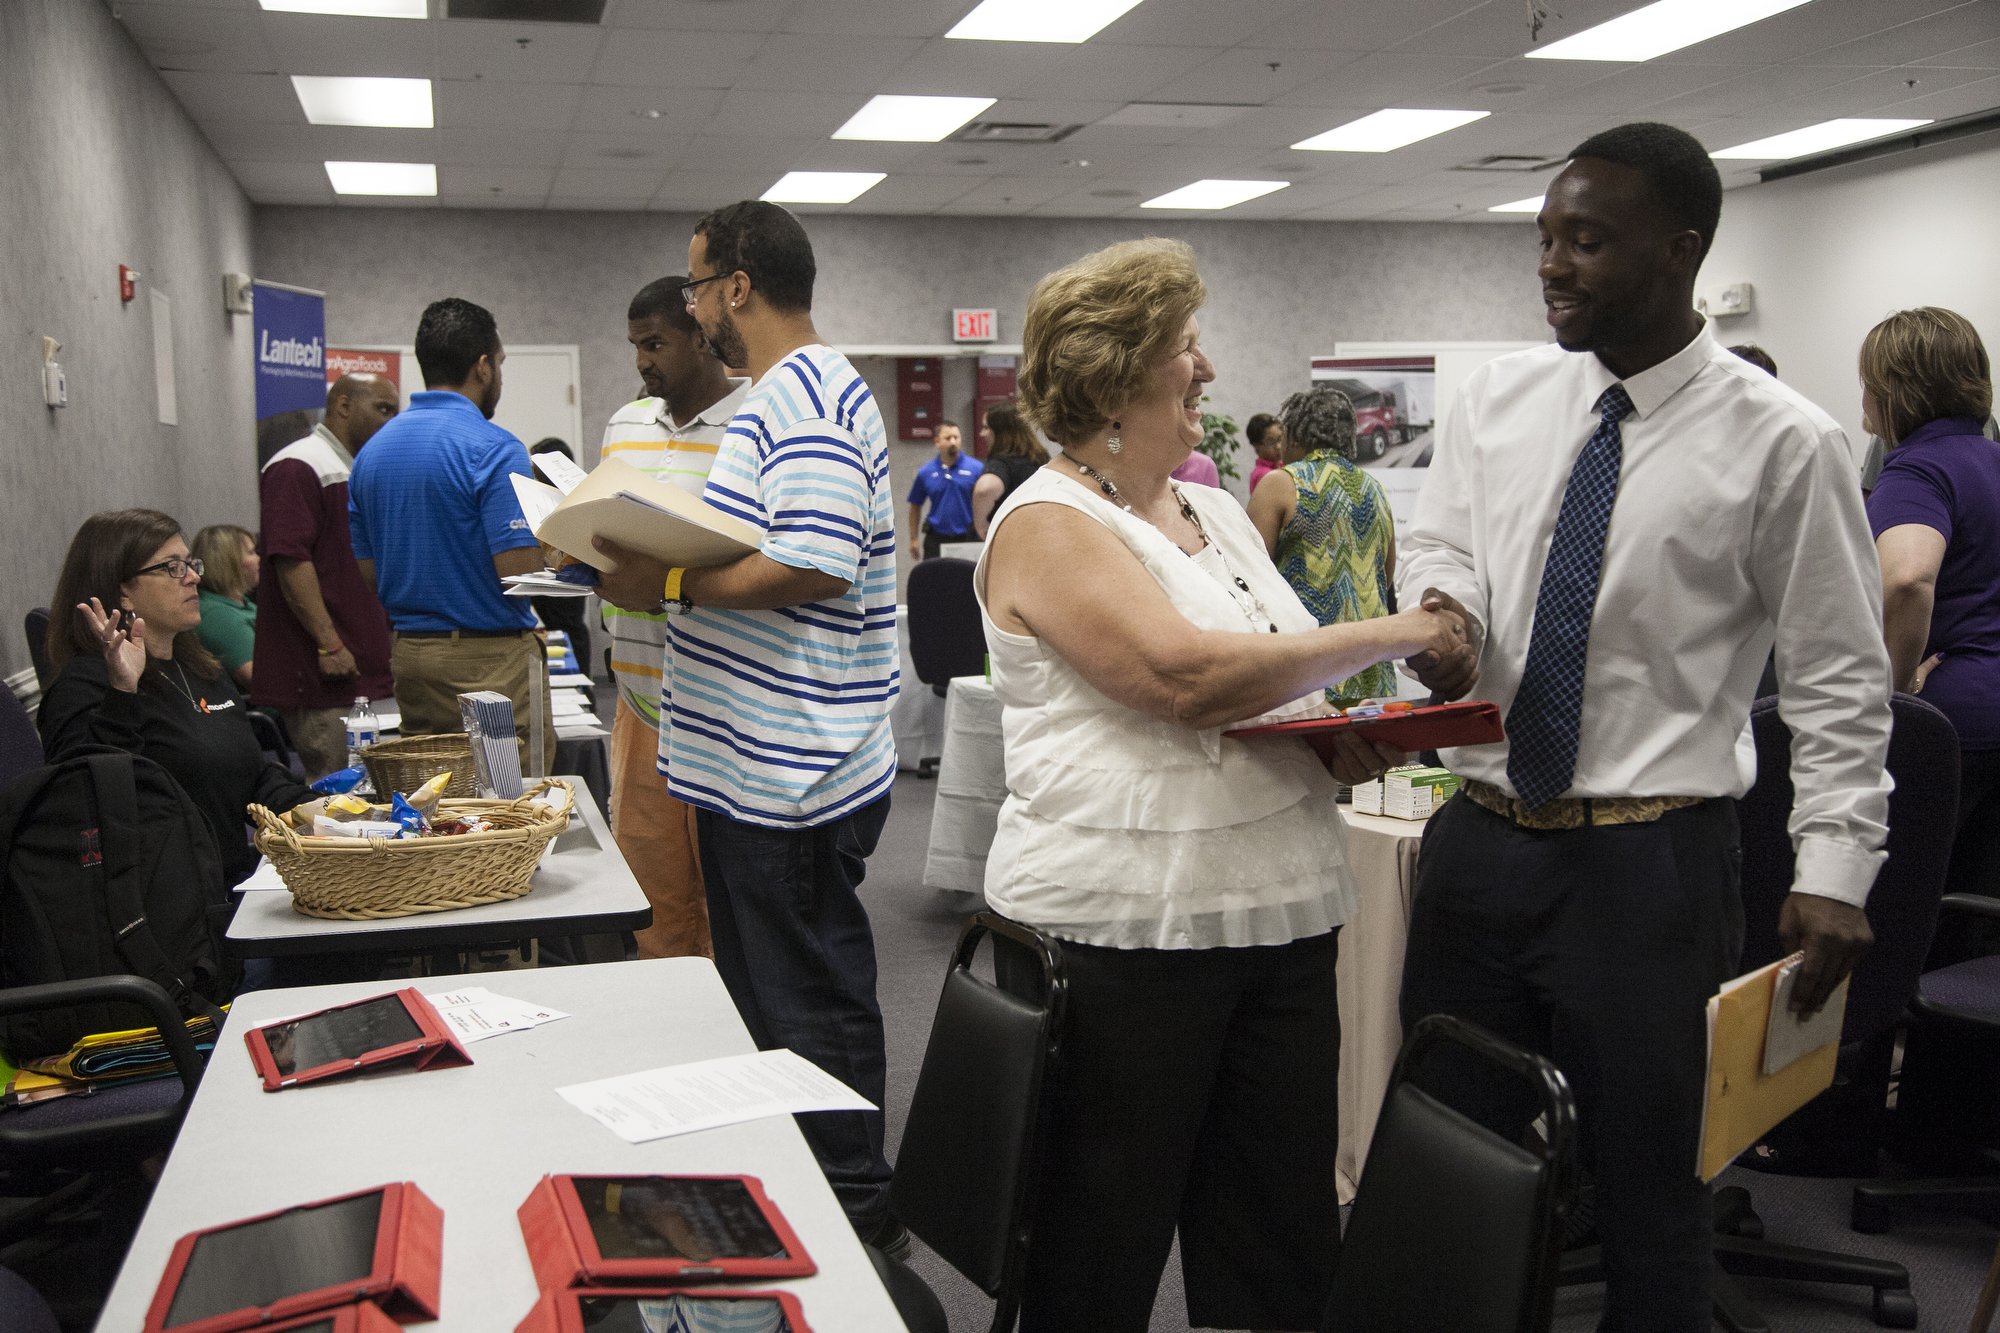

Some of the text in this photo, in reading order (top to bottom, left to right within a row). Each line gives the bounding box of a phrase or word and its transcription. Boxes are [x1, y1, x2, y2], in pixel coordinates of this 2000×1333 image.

[957, 312, 992, 337] EXIT
[261, 329, 322, 368] Lantech
[206, 699, 235, 711] mondi
